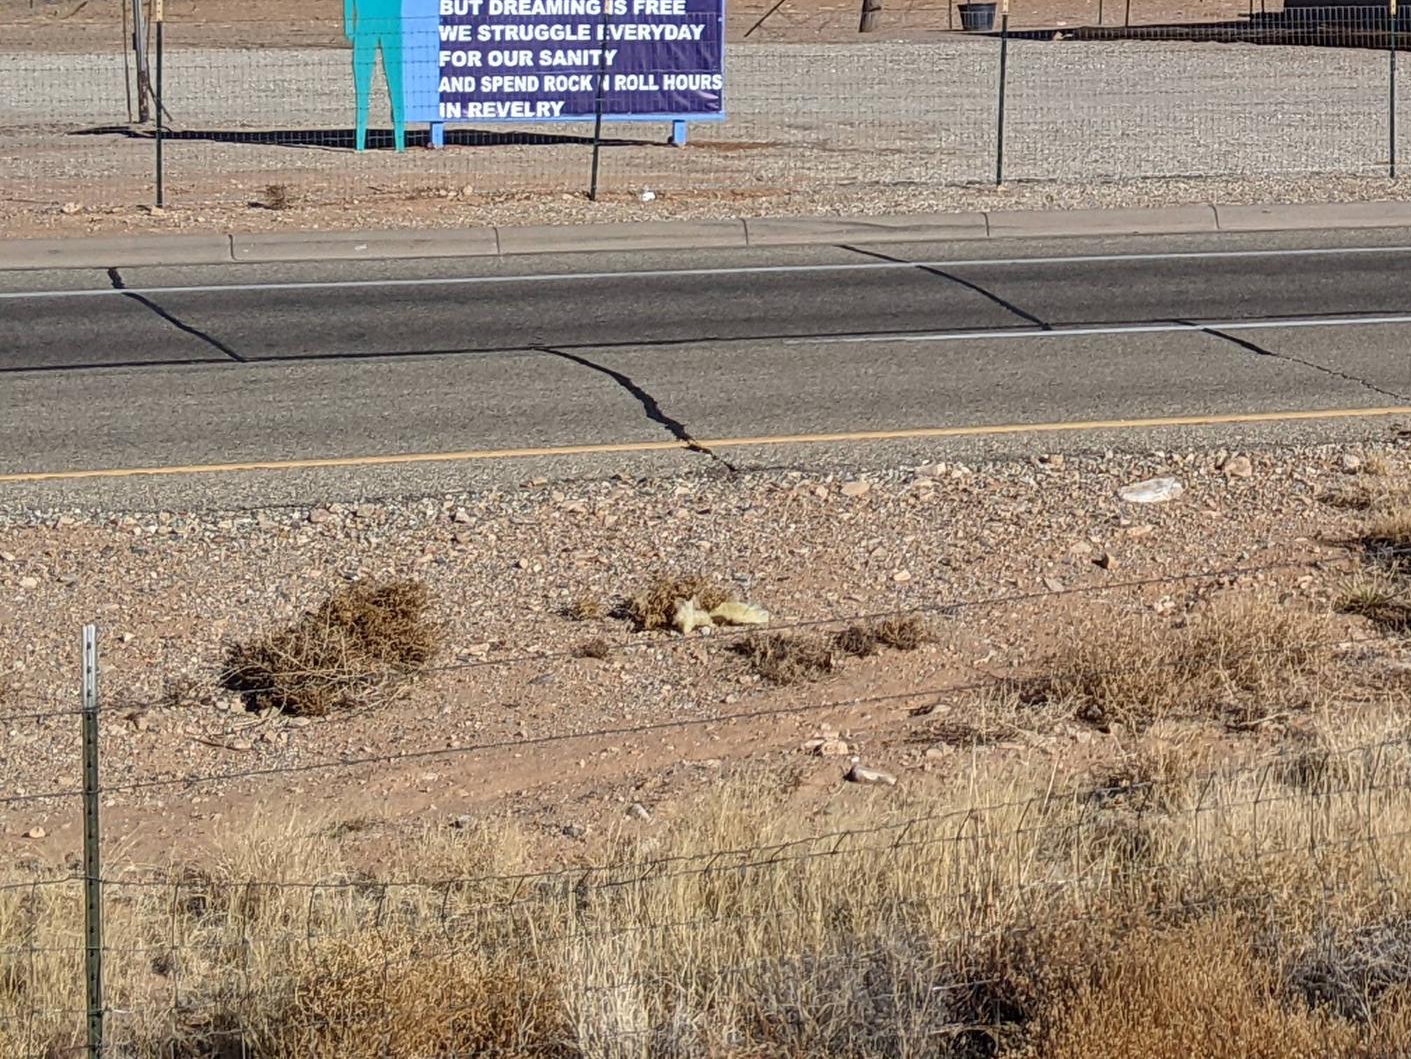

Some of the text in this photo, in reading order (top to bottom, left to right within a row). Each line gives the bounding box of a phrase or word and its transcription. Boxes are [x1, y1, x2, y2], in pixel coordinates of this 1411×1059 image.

[439, 0, 483, 16] BUT
[633, 0, 686, 15] FREE
[438, 23, 706, 42] WE STRUGGLE EVERYDAY
[438, 49, 618, 67] FOR OUR SANITY
[438, 76, 475, 93] AND
[481, 75, 539, 92] SPEND
[544, 74, 593, 92] ROCK
[614, 74, 659, 91] ROLL
[663, 73, 723, 91] HOURS
[439, 101, 565, 118] IN REVELRY
